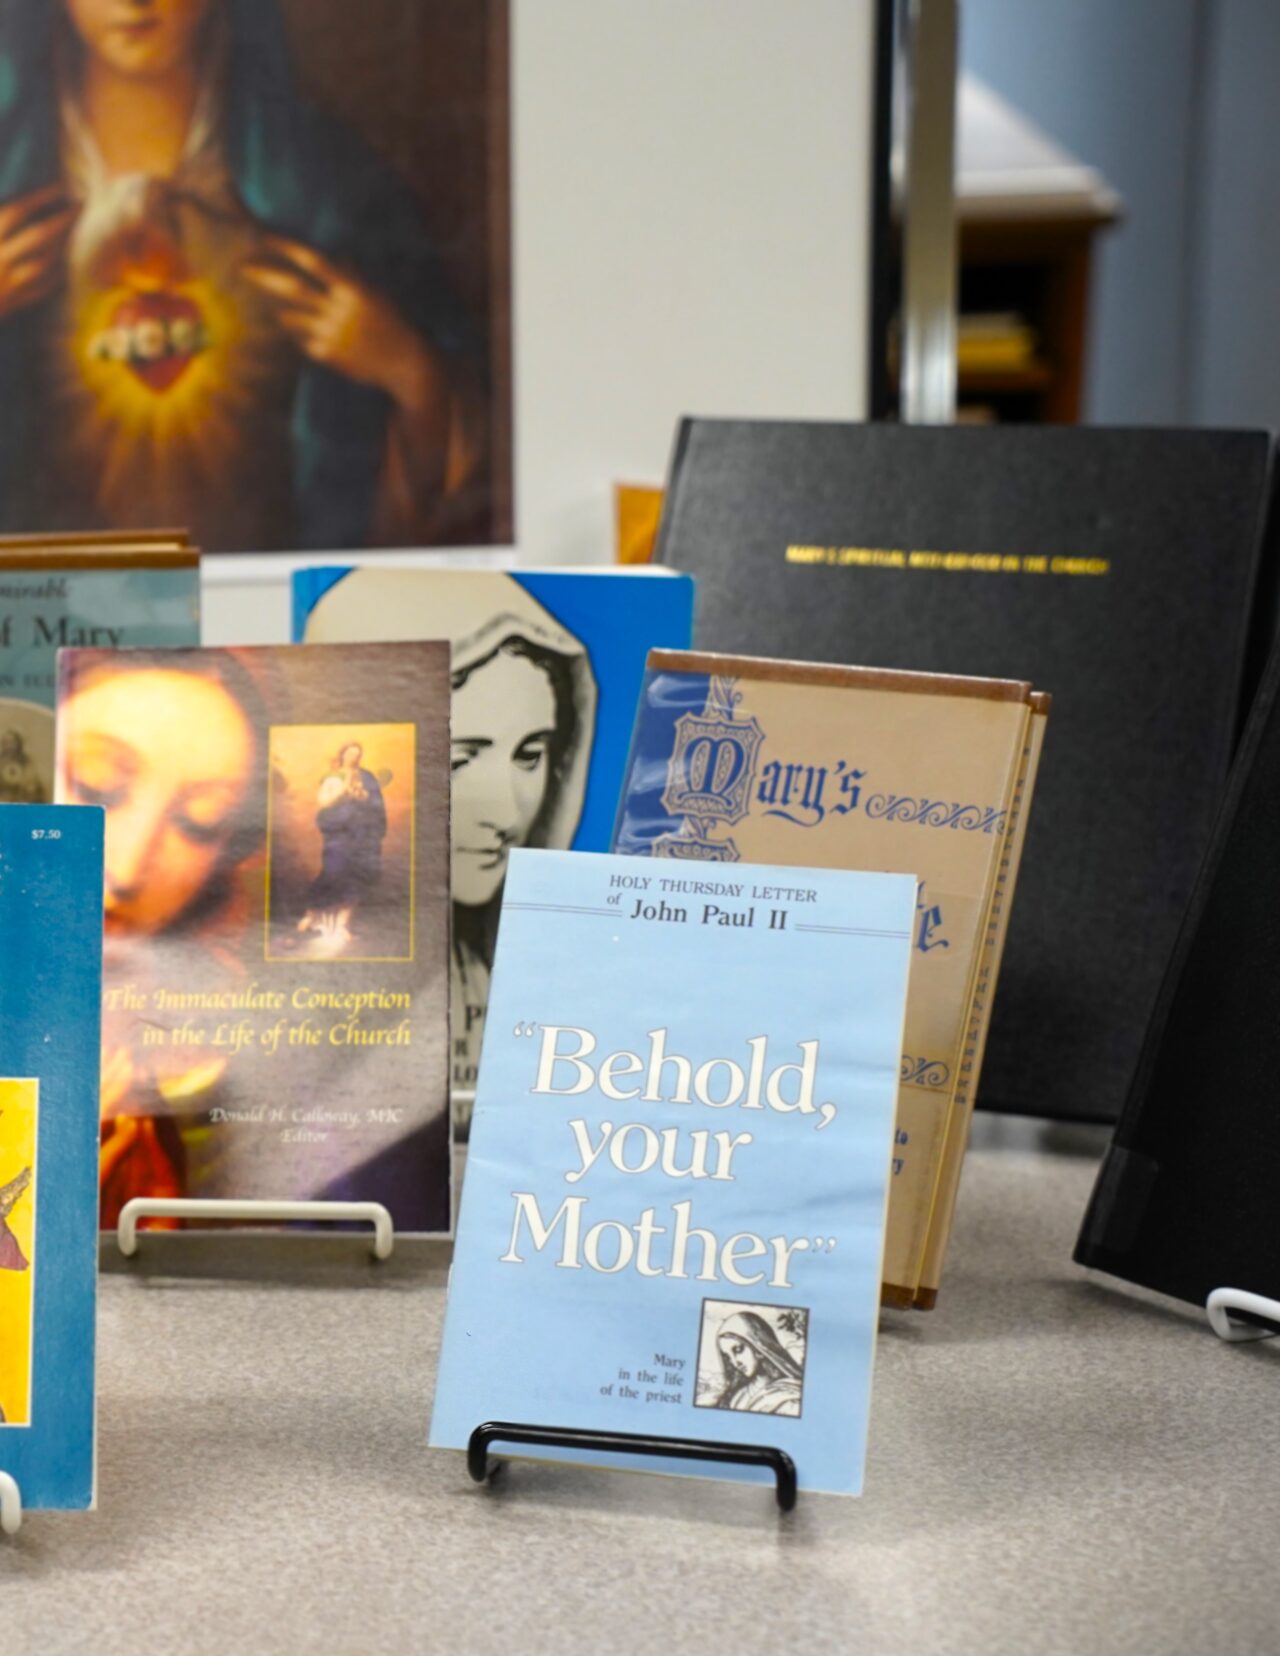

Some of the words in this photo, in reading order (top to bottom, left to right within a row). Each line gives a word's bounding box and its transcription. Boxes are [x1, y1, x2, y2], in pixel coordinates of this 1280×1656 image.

[31, 829, 62, 840] $7.50
[609, 873, 652, 891] HOLY
[659, 878, 744, 898] THURSDAY
[752, 885, 818, 903] LETTER
[606, 893, 623, 906] of
[630, 899, 689, 924] John
[701, 903, 755, 929] Paul
[768, 909, 788, 931] II
[106, 984, 147, 1012] The
[154, 983, 286, 1011] Immaculate
[291, 986, 412, 1021] Conception
[142, 1023, 165, 1047] in
[171, 1020, 205, 1046] the
[211, 1019, 254, 1057] Life
[260, 1018, 283, 1057] of
[289, 1018, 322, 1046] the
[329, 1018, 412, 1047] Church
[513, 1021, 838, 1131] “Behold,
[208, 1106, 264, 1124] Donald
[268, 1108, 288, 1124] H.
[291, 1106, 362, 1129] Calloway,
[366, 1108, 403, 1124] MIC
[279, 1127, 328, 1145] Editor
[564, 1118, 753, 1183] your
[498, 1191, 838, 1289] Mother”
[653, 1351, 686, 1370] Mary
[618, 1368, 630, 1381] in
[636, 1369, 657, 1384] the
[663, 1371, 684, 1387] life
[599, 1383, 613, 1396] of
[619, 1384, 640, 1399] the
[645, 1388, 682, 1405] priest
